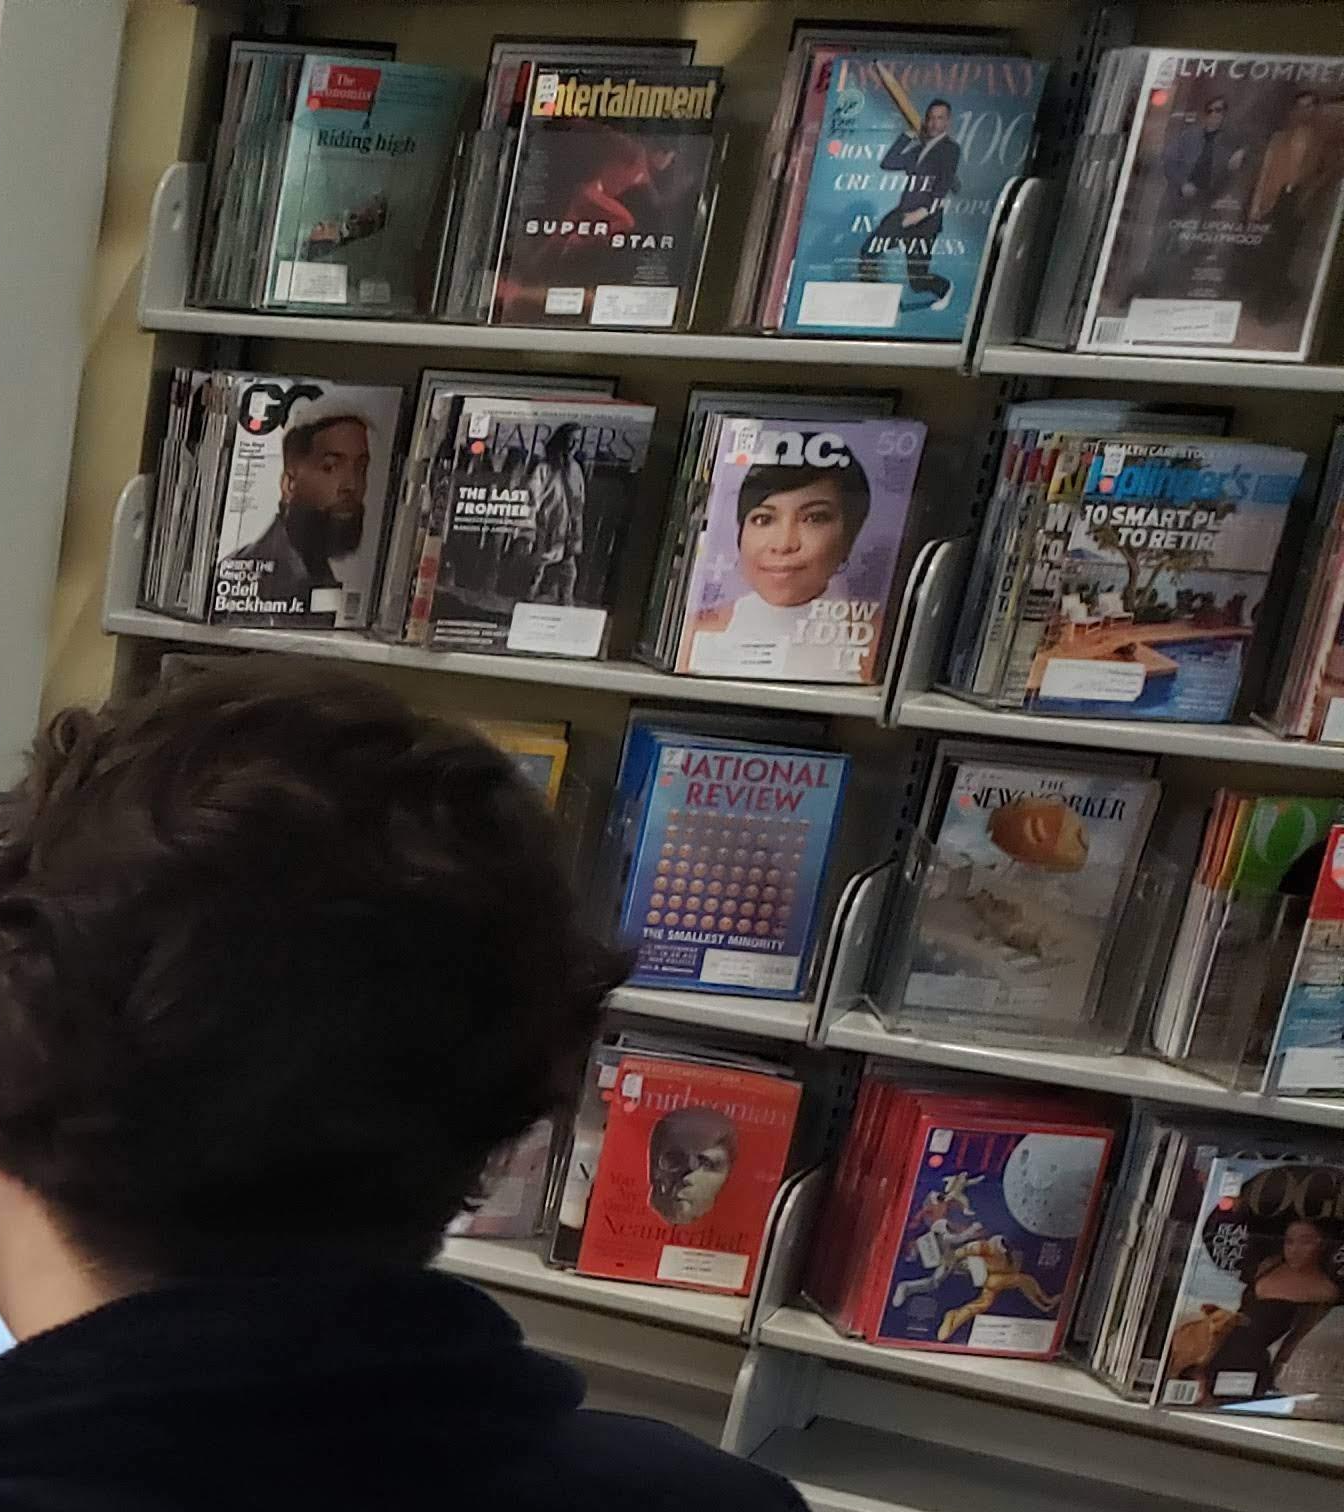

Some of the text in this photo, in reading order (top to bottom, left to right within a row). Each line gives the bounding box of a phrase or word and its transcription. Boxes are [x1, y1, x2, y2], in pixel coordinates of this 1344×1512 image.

[317, 128, 416, 157] Riding high
[526, 219, 609, 236] SUPER
[611, 233, 675, 249] STAR
[868, 237, 967, 256] BUSINESS
[459, 486, 529, 502] THE LAST
[456, 501, 530, 517] FRONTIER
[1084, 505, 1108, 525] 10
[1110, 504, 1192, 529] SMART
[1118, 528, 1148, 548] TO
[217, 581, 258, 596] Odell
[215, 596, 304, 614] Beckham Jr.
[809, 600, 880, 622] HOW
[809, 621, 875, 647] DID
[682, 752, 829, 789] NATIONAL
[686, 781, 805, 813] REVIEW
[643, 926, 785, 951] THE SMALLEST MINORITY
[631, 1083, 789, 1127] mithsonian
